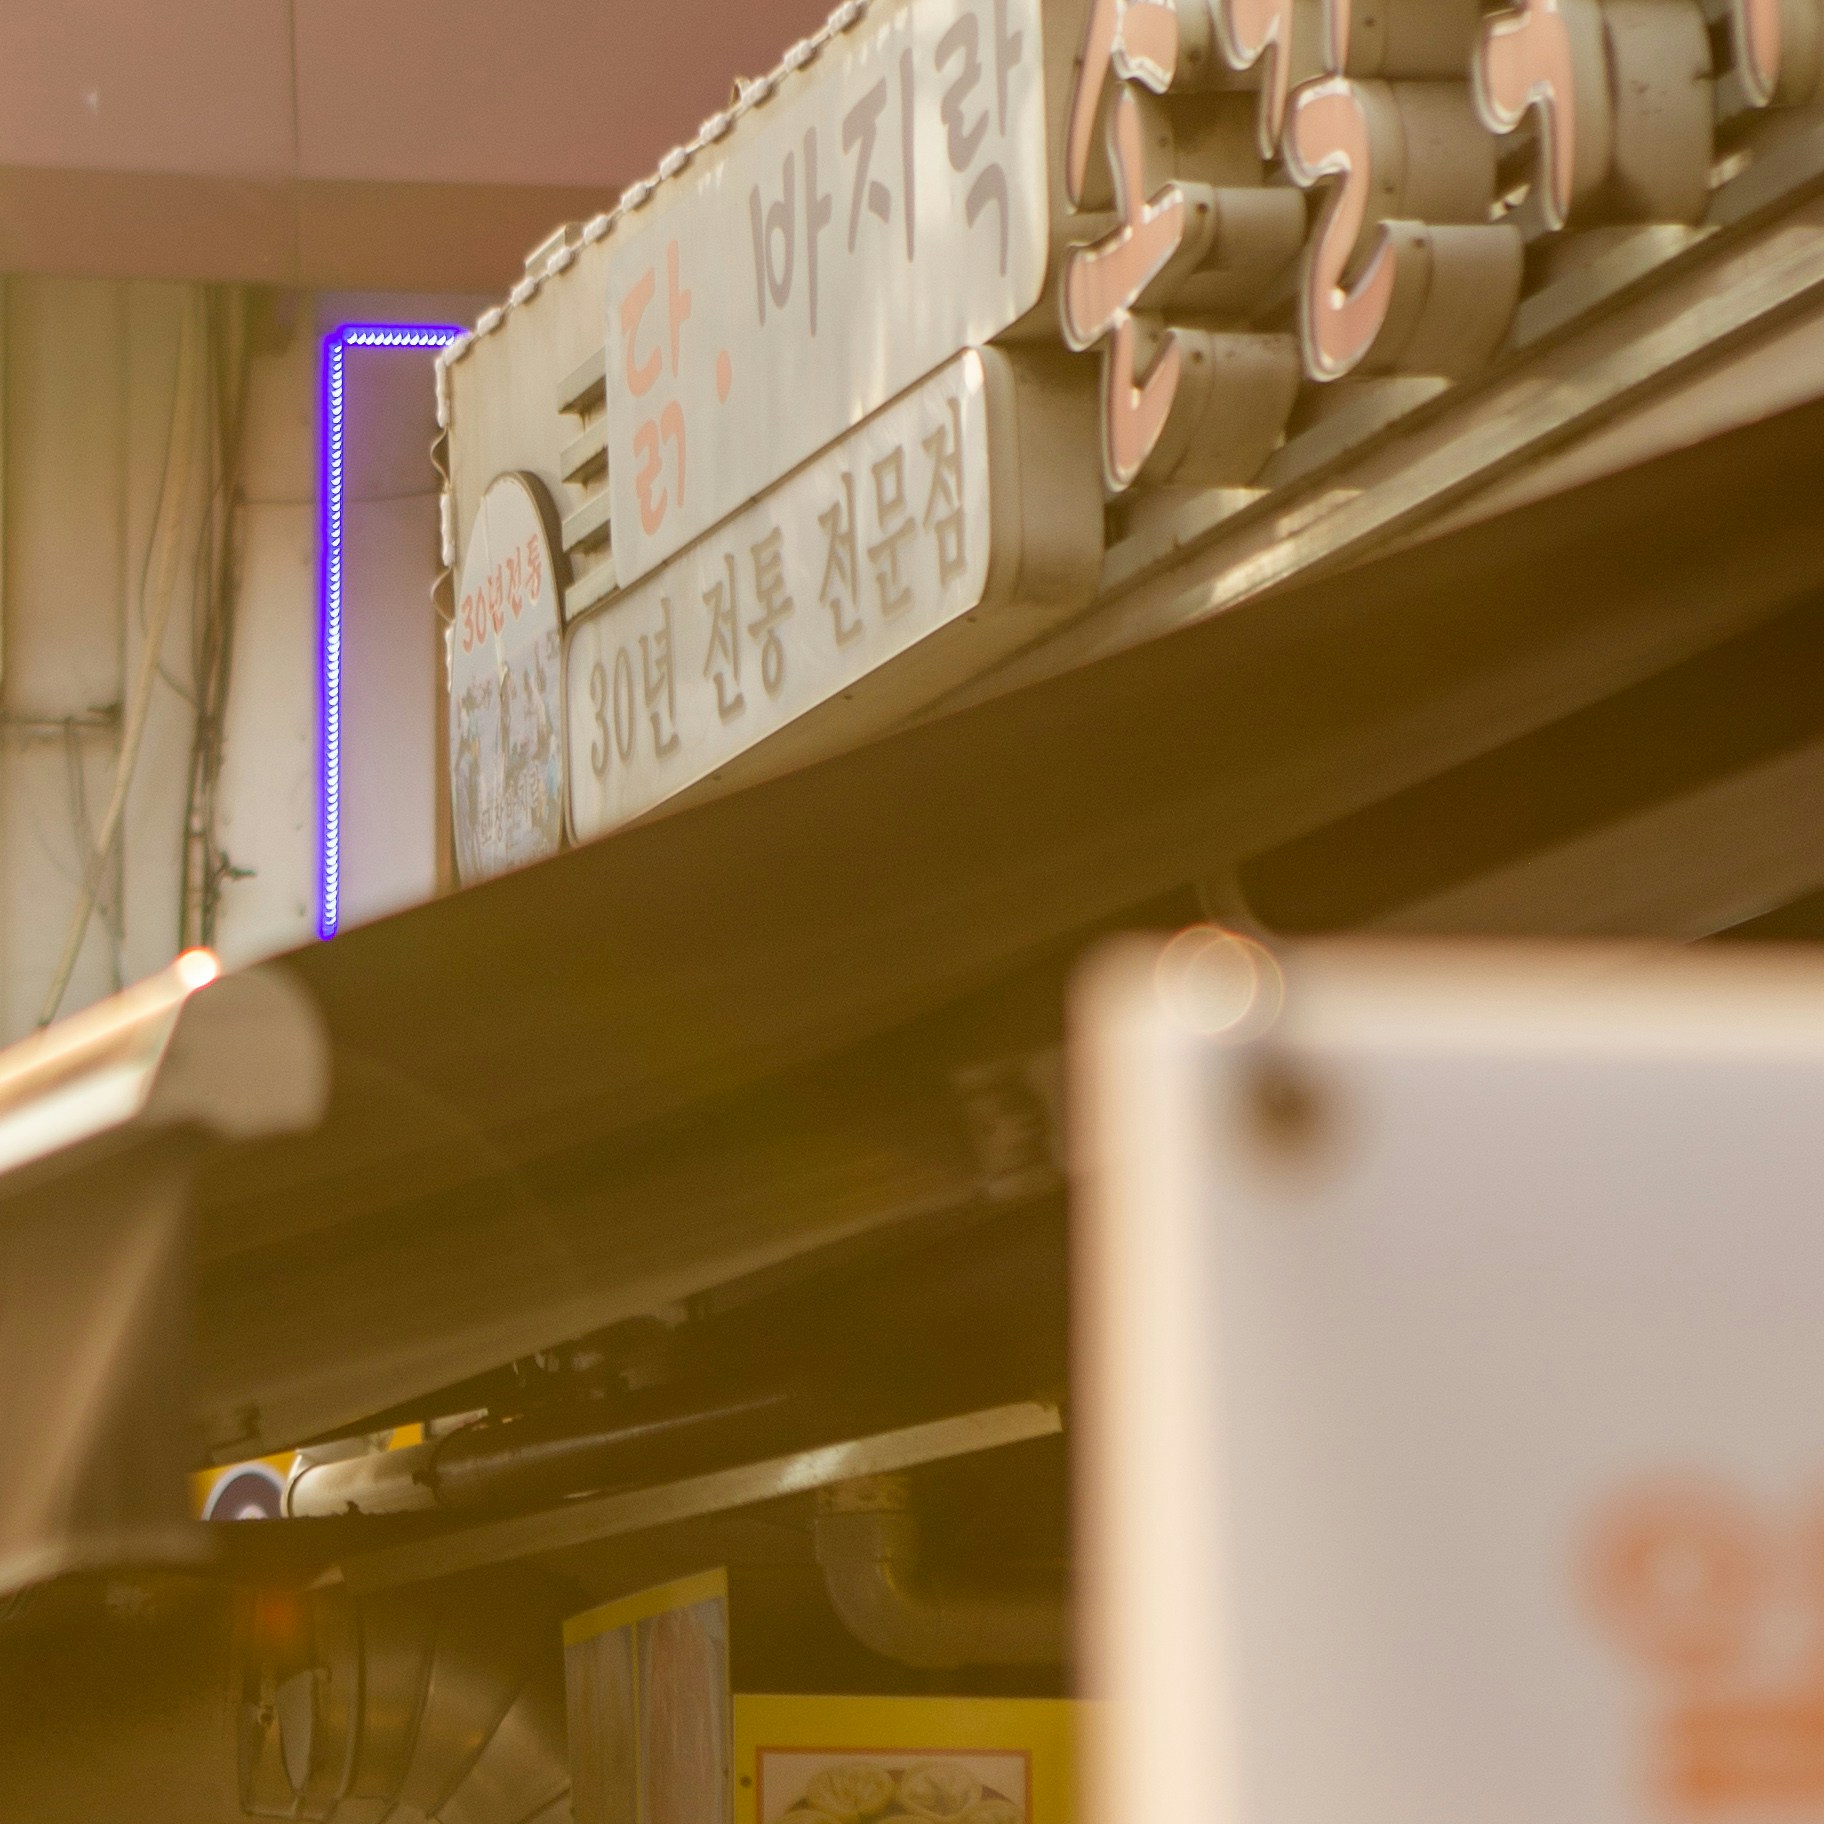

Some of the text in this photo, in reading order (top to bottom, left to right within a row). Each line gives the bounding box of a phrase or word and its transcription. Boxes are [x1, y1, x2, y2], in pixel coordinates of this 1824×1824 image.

[588, 396, 966, 780] 30년 전통 전문점
